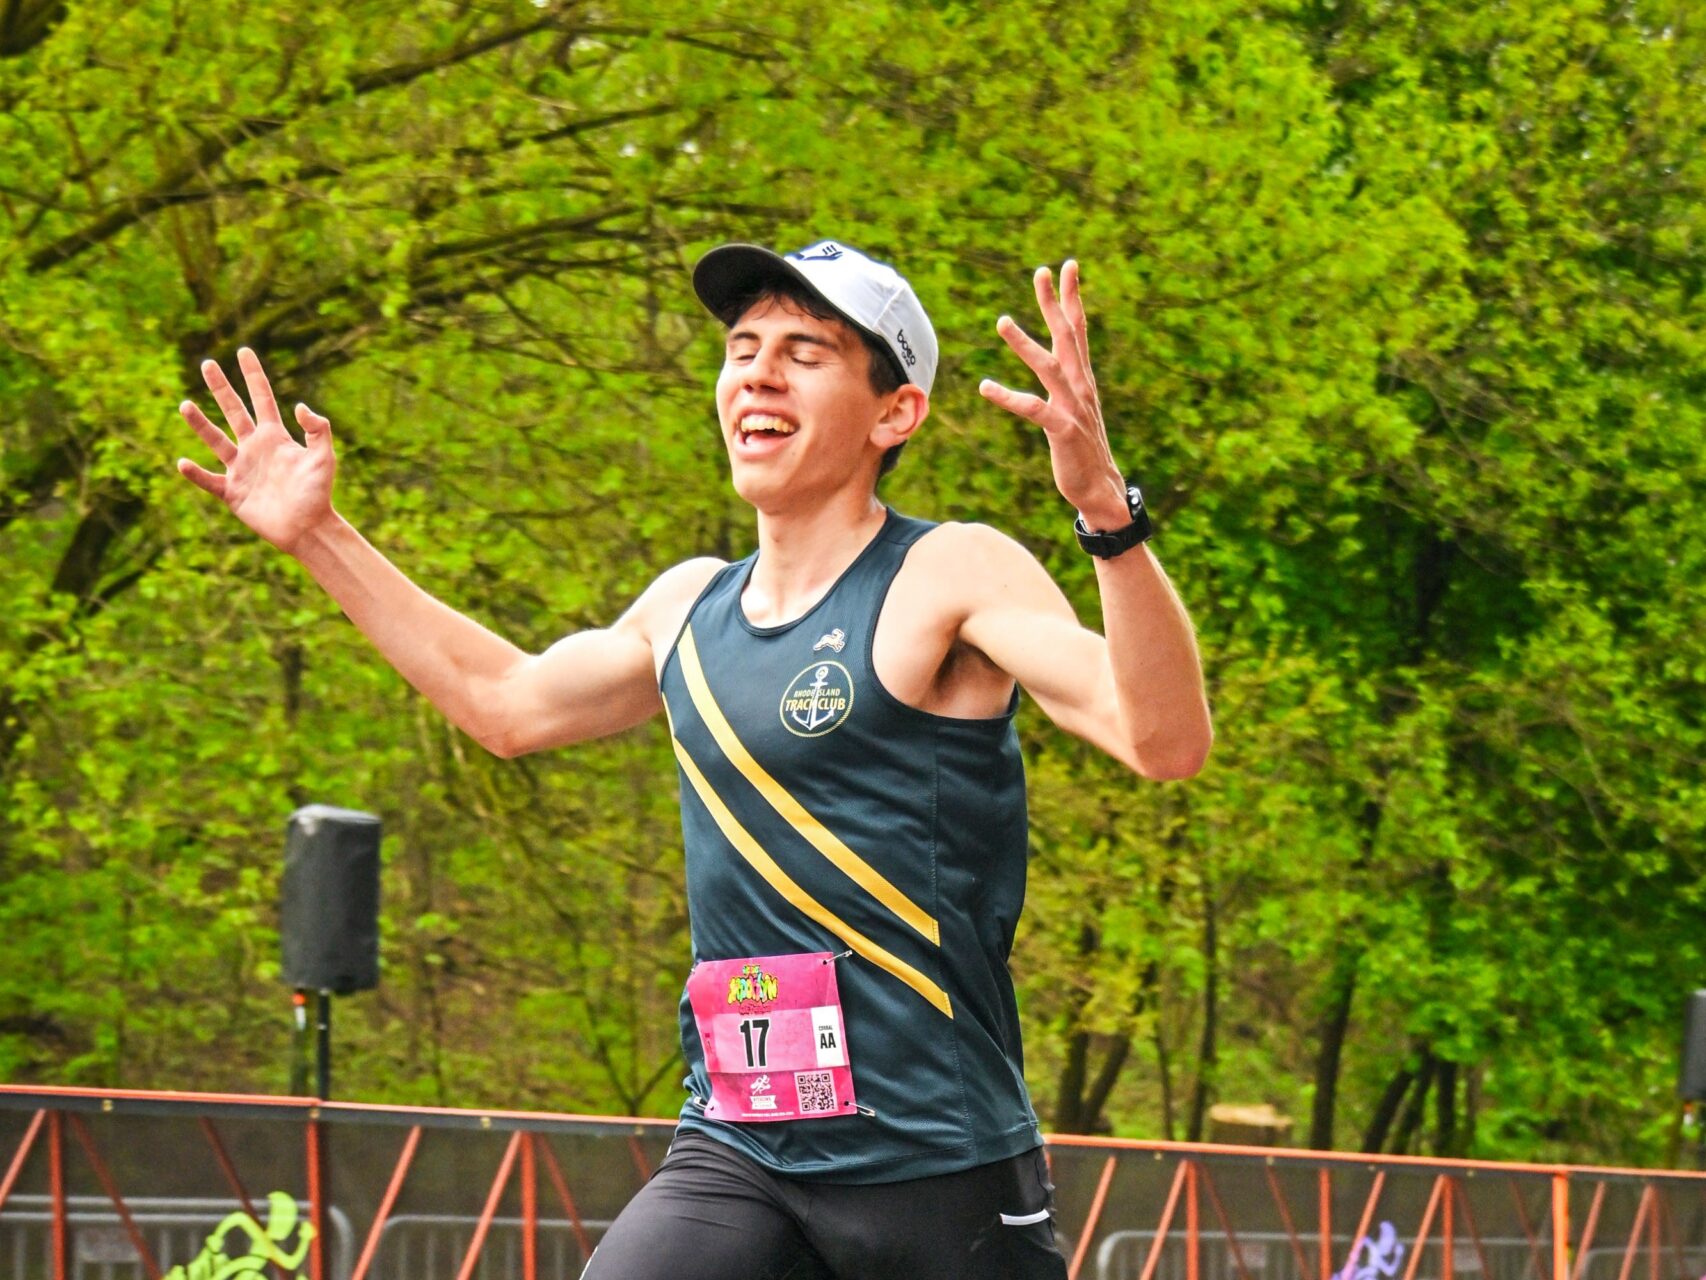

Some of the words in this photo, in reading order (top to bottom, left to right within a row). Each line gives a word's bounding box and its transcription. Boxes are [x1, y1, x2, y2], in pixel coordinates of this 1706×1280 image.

[818, 698, 846, 710] CLUB
[740, 1019, 769, 1067] 17
[820, 1032, 836, 1049] AA
